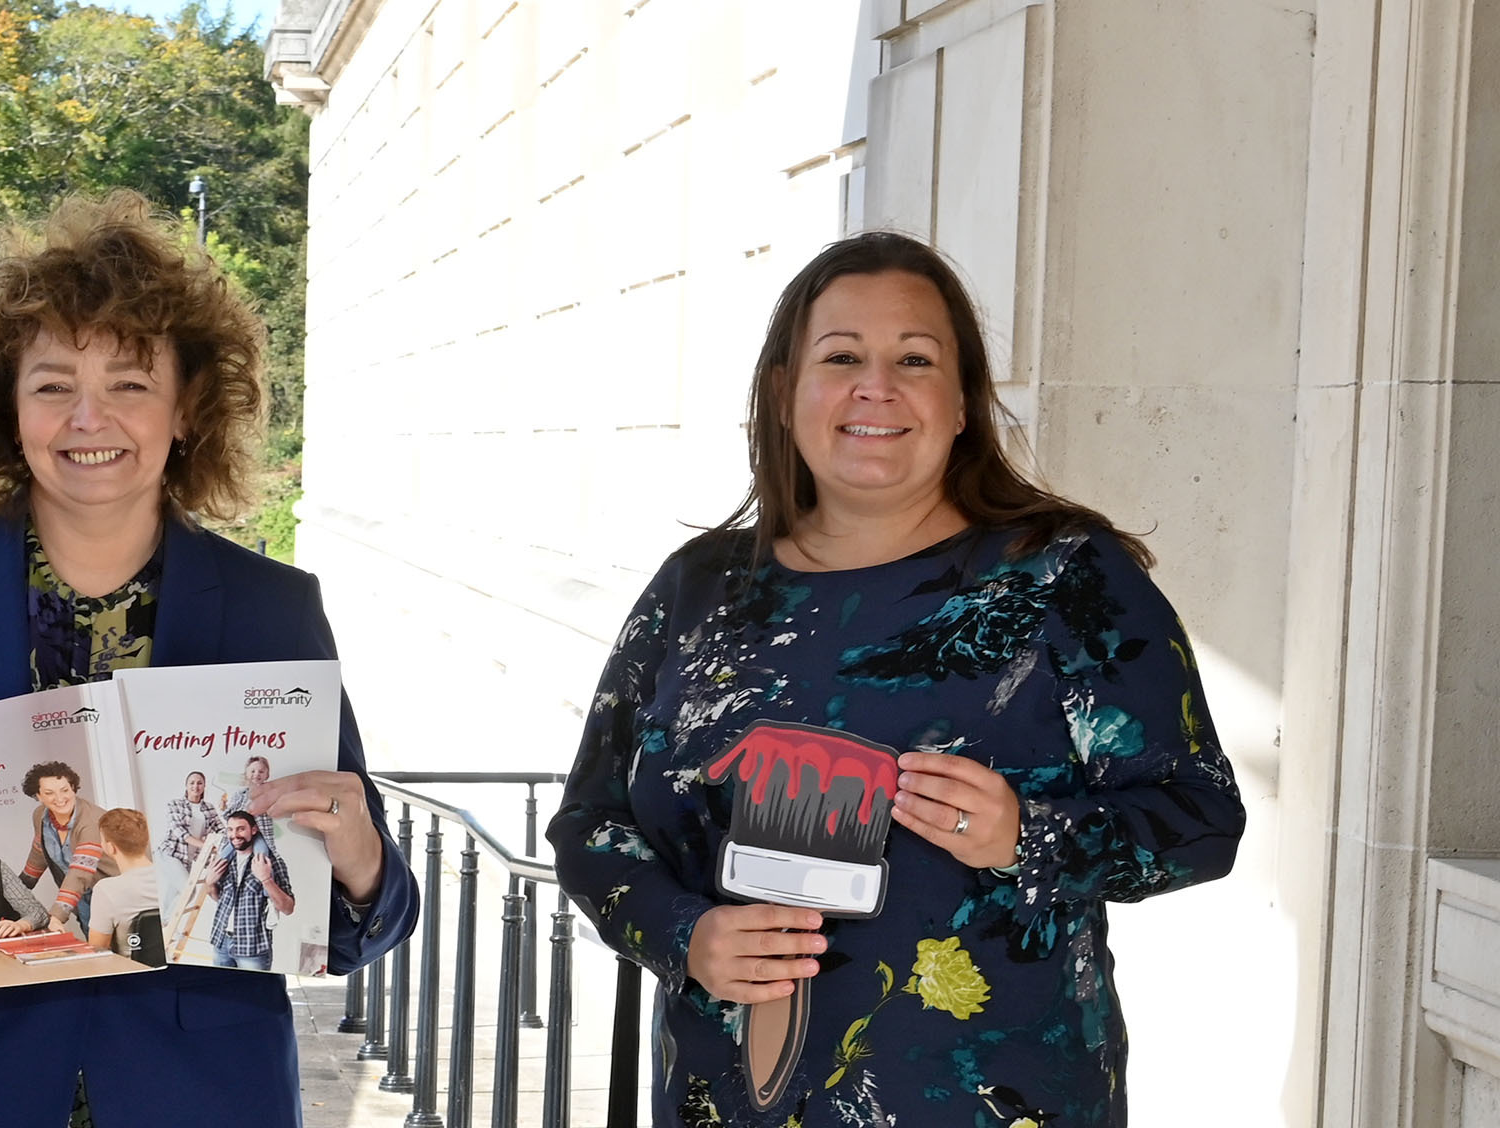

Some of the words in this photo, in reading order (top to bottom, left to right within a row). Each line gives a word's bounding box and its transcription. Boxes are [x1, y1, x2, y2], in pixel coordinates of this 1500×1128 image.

[244, 687, 280, 697] simon
[244, 694, 312, 708] community
[31, 710, 68, 722] simon
[32, 713, 100, 729] community
[133, 730, 215, 758] Creating
[222, 725, 286, 755] Homes
